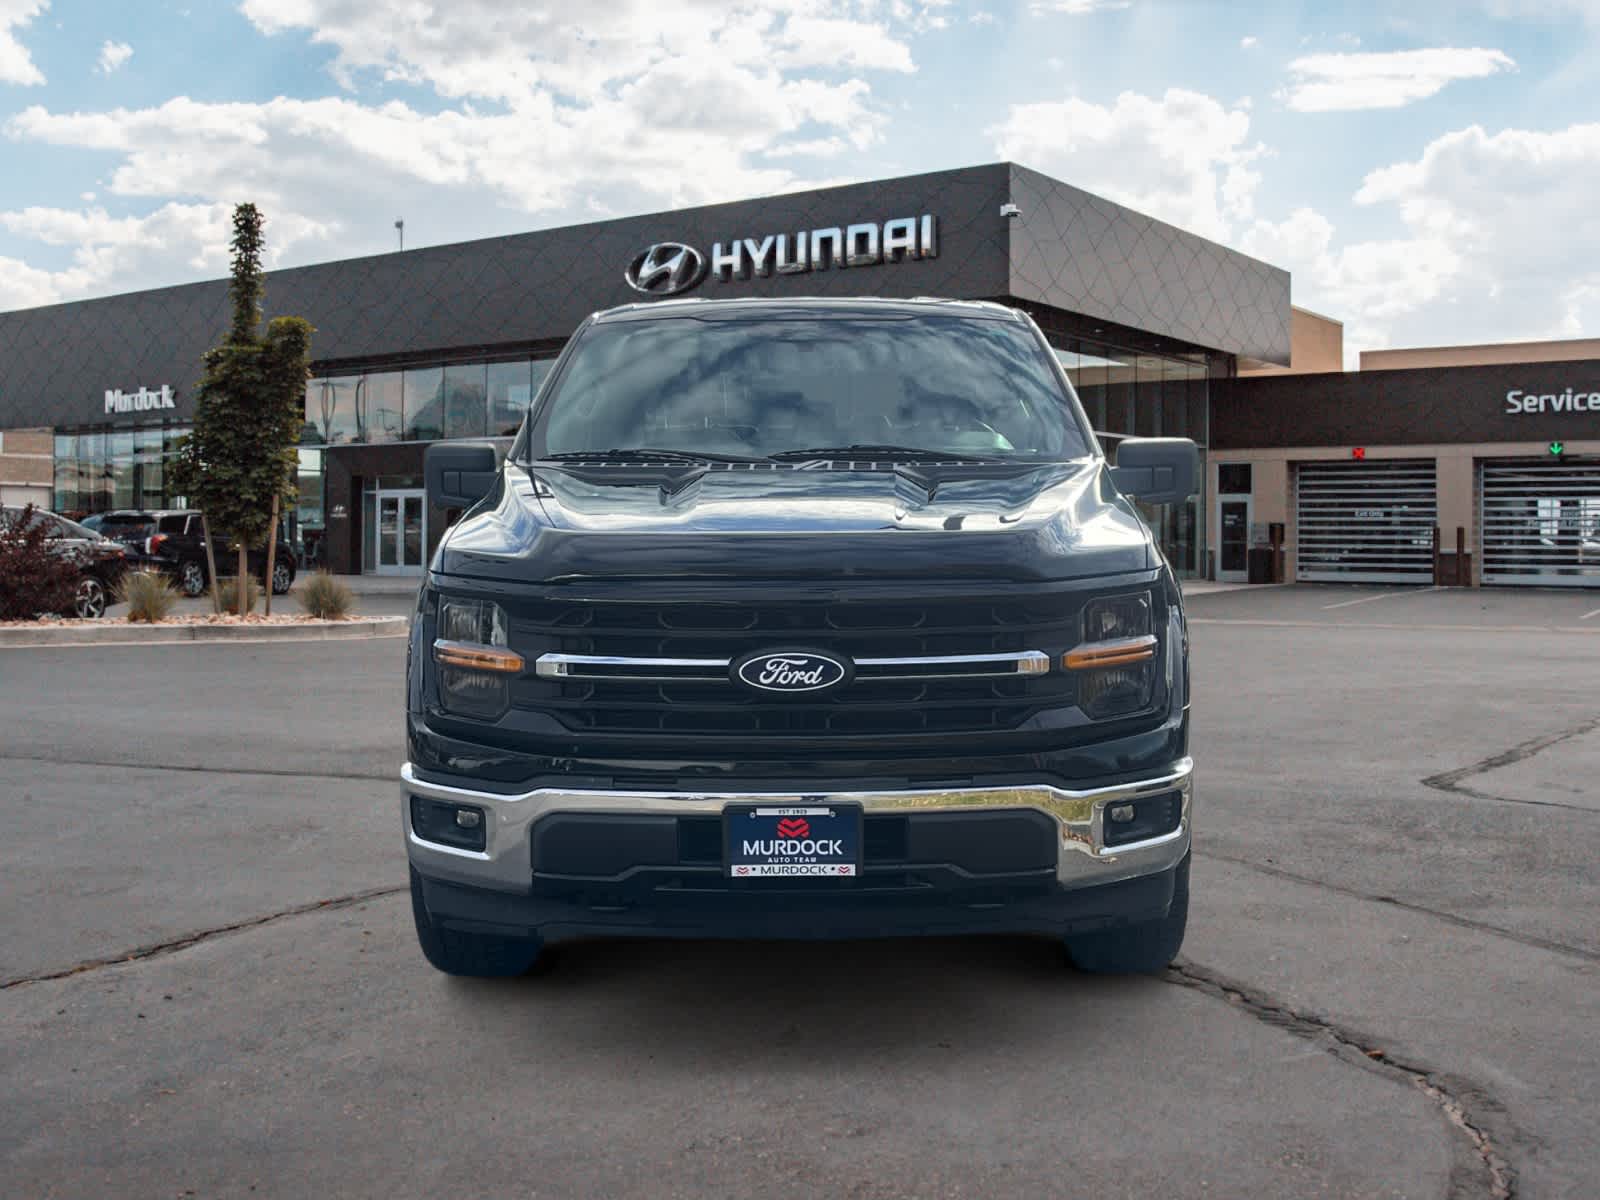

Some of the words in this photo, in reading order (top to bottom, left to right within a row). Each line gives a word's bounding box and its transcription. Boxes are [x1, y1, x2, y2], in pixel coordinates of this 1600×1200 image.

[712, 214, 935, 280] HYUNDAI
[104, 384, 176, 414] Murdock
[1505, 387, 1600, 414] Service
[759, 658, 824, 684] Ford
[743, 839, 843, 856] MURDOCK
[760, 865, 827, 875] MURDOCK
